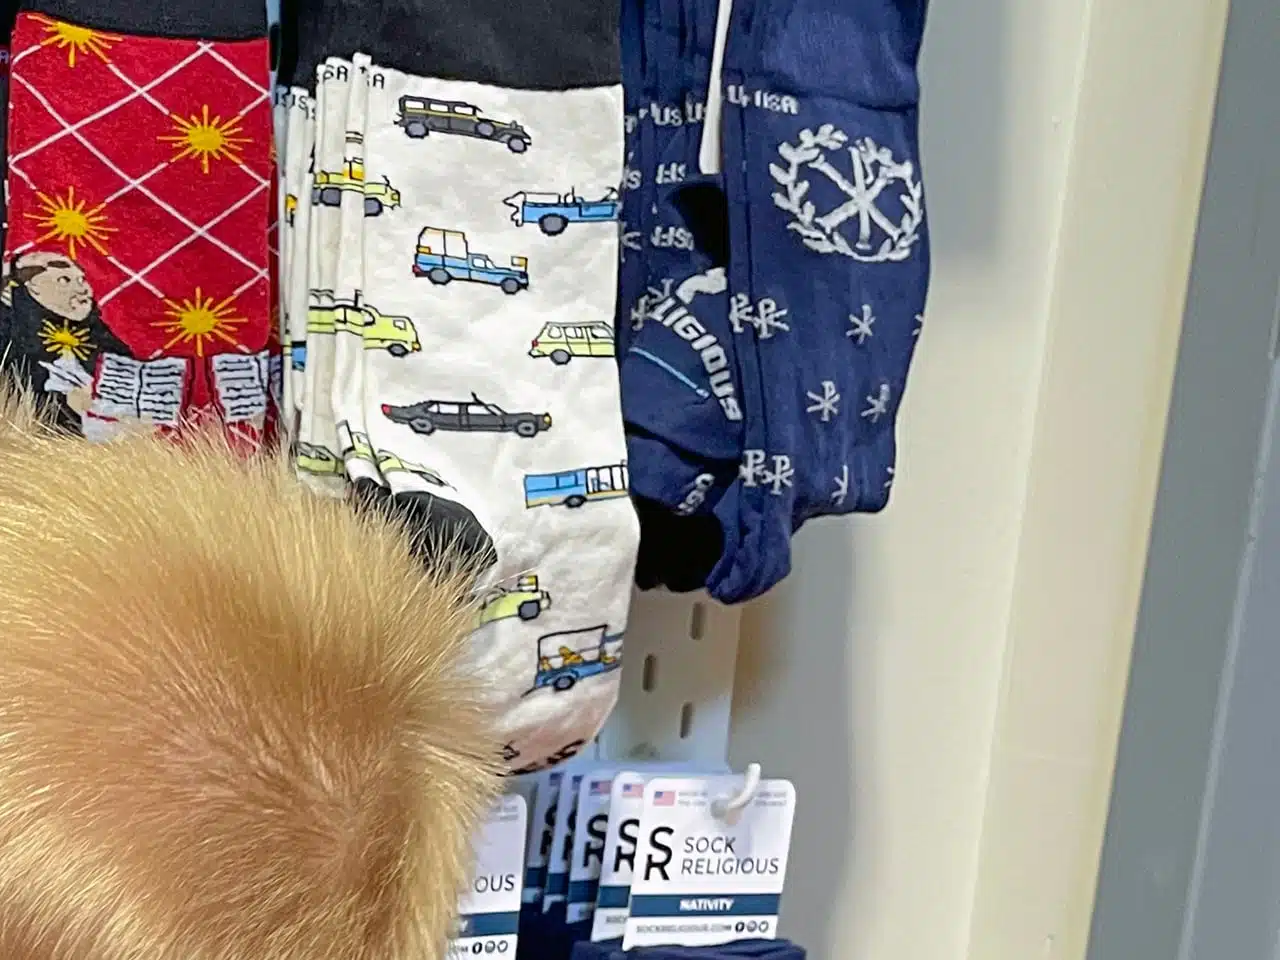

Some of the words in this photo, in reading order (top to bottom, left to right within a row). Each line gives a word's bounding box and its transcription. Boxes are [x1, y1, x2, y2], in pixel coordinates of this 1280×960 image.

[650, 297, 743, 420] LIGIOUS
[683, 836, 736, 854] SOCK
[681, 858, 779, 875] RELIGIOUS
[679, 898, 734, 911] NATIVITY
